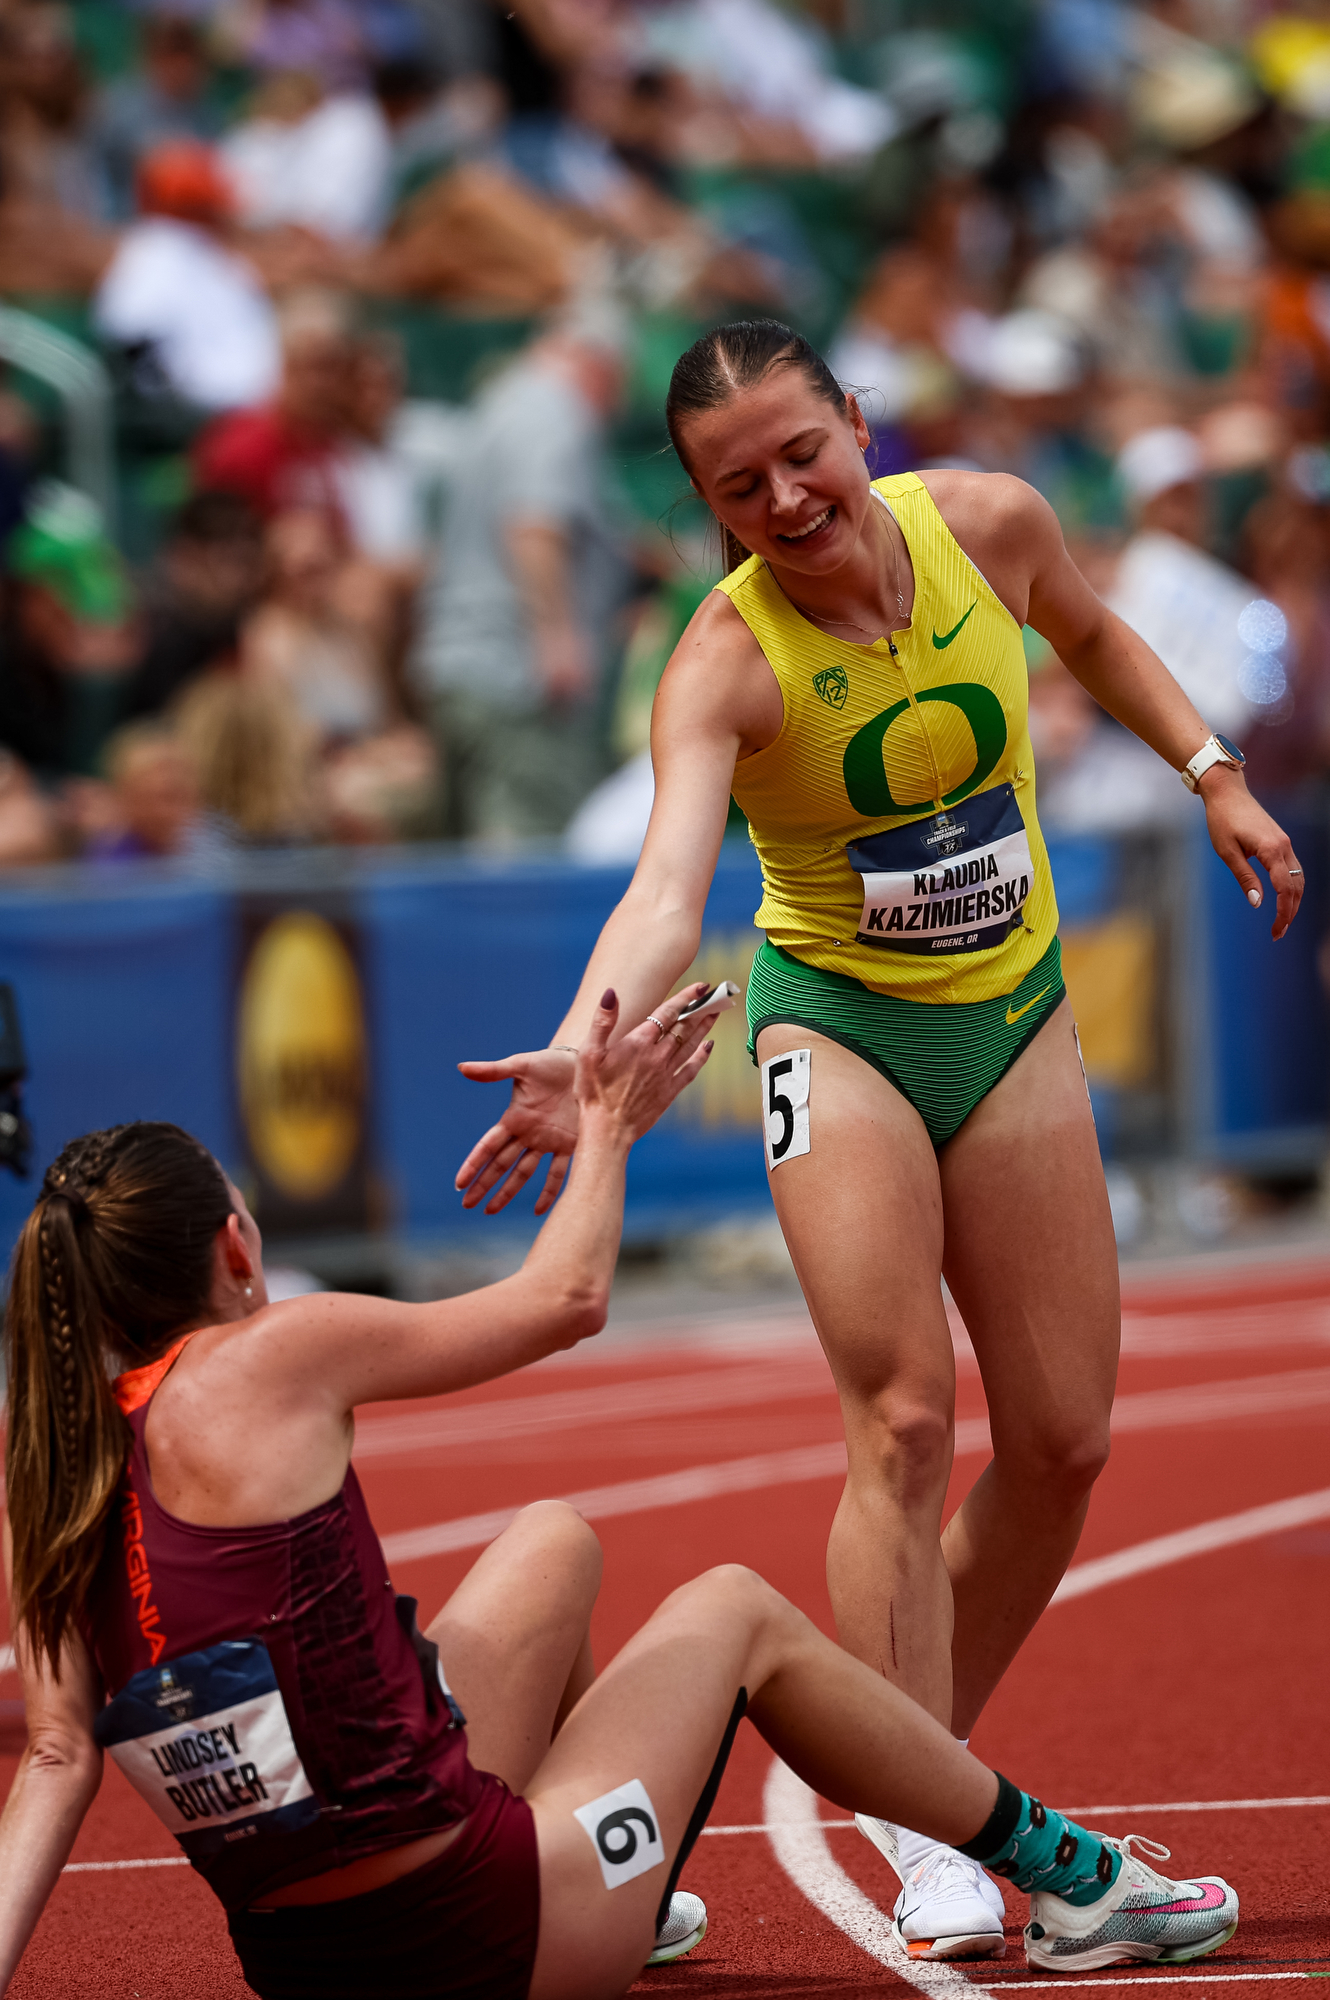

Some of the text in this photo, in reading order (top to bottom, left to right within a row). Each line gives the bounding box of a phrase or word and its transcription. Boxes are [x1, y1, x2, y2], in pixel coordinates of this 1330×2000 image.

[815, 668, 846, 697] PAC
[826, 685, 844, 703] 12
[843, 683, 1007, 817] O
[926, 826, 966, 845] CHAMPIONSHIPS
[913, 853, 999, 896] KLAUDIA
[867, 875, 1029, 931] KAZIMIERSKA
[931, 933, 979, 949] EUGENE, OR
[768, 1058, 794, 1160] 5
[151, 1723, 241, 1777] LINDSEY
[165, 1762, 269, 1822] BUTLER
